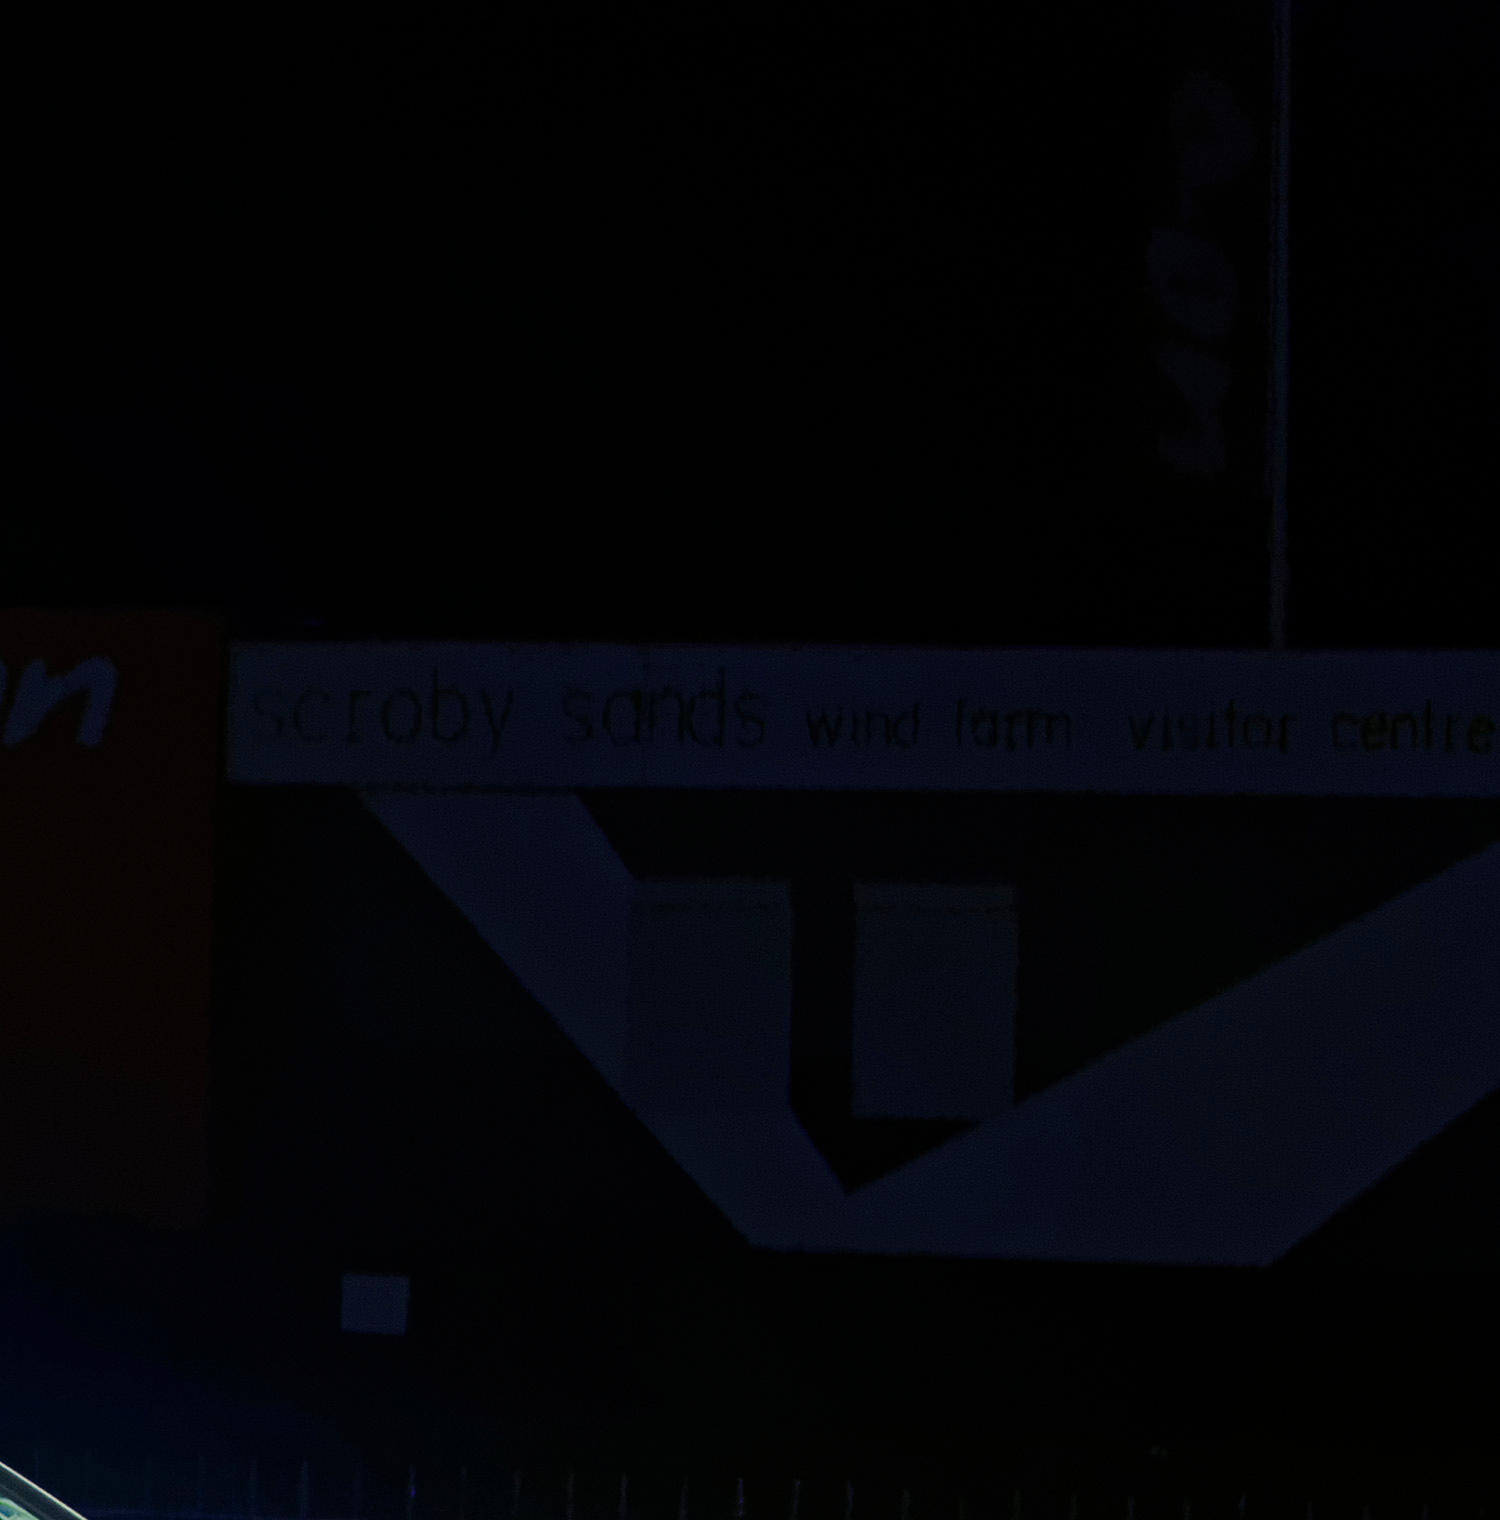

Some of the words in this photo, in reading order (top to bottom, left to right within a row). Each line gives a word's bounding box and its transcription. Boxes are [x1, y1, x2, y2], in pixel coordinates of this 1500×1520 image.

[254, 666, 514, 757] scroby
[562, 666, 767, 748] sands
[806, 703, 921, 748] wind
[953, 699, 1073, 751] farm
[1127, 699, 1295, 752] visitor
[1329, 699, 1496, 754] centre
